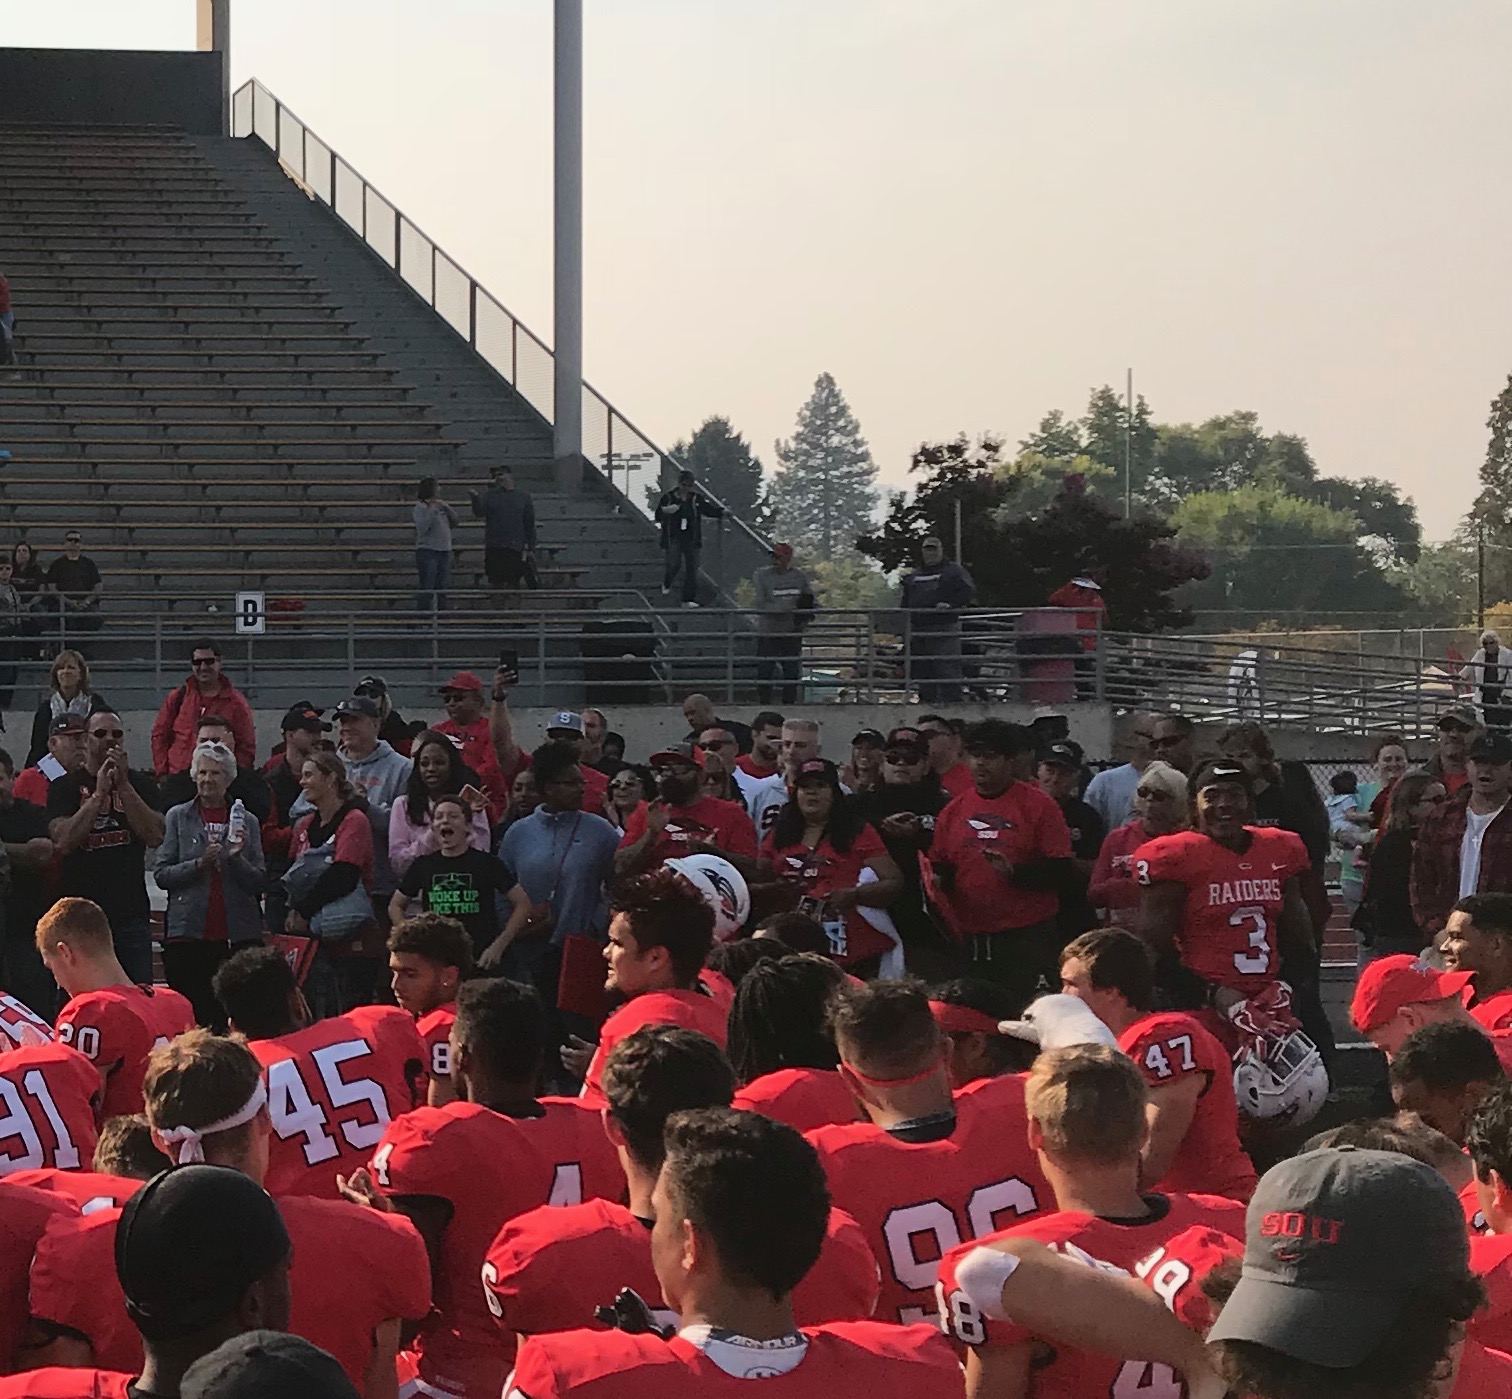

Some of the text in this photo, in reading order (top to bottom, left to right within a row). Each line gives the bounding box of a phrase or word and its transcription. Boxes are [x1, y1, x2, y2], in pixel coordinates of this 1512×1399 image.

[243, 599, 258, 627] D
[1136, 860, 1151, 885] 3
[428, 889, 480, 902] WOKE UP
[1209, 878, 1282, 906] RAIDERS
[1228, 905, 1272, 976] 3
[1143, 1034, 1198, 1080] 47
[267, 1037, 393, 1166] 45
[1261, 1211, 1344, 1245] SOU
